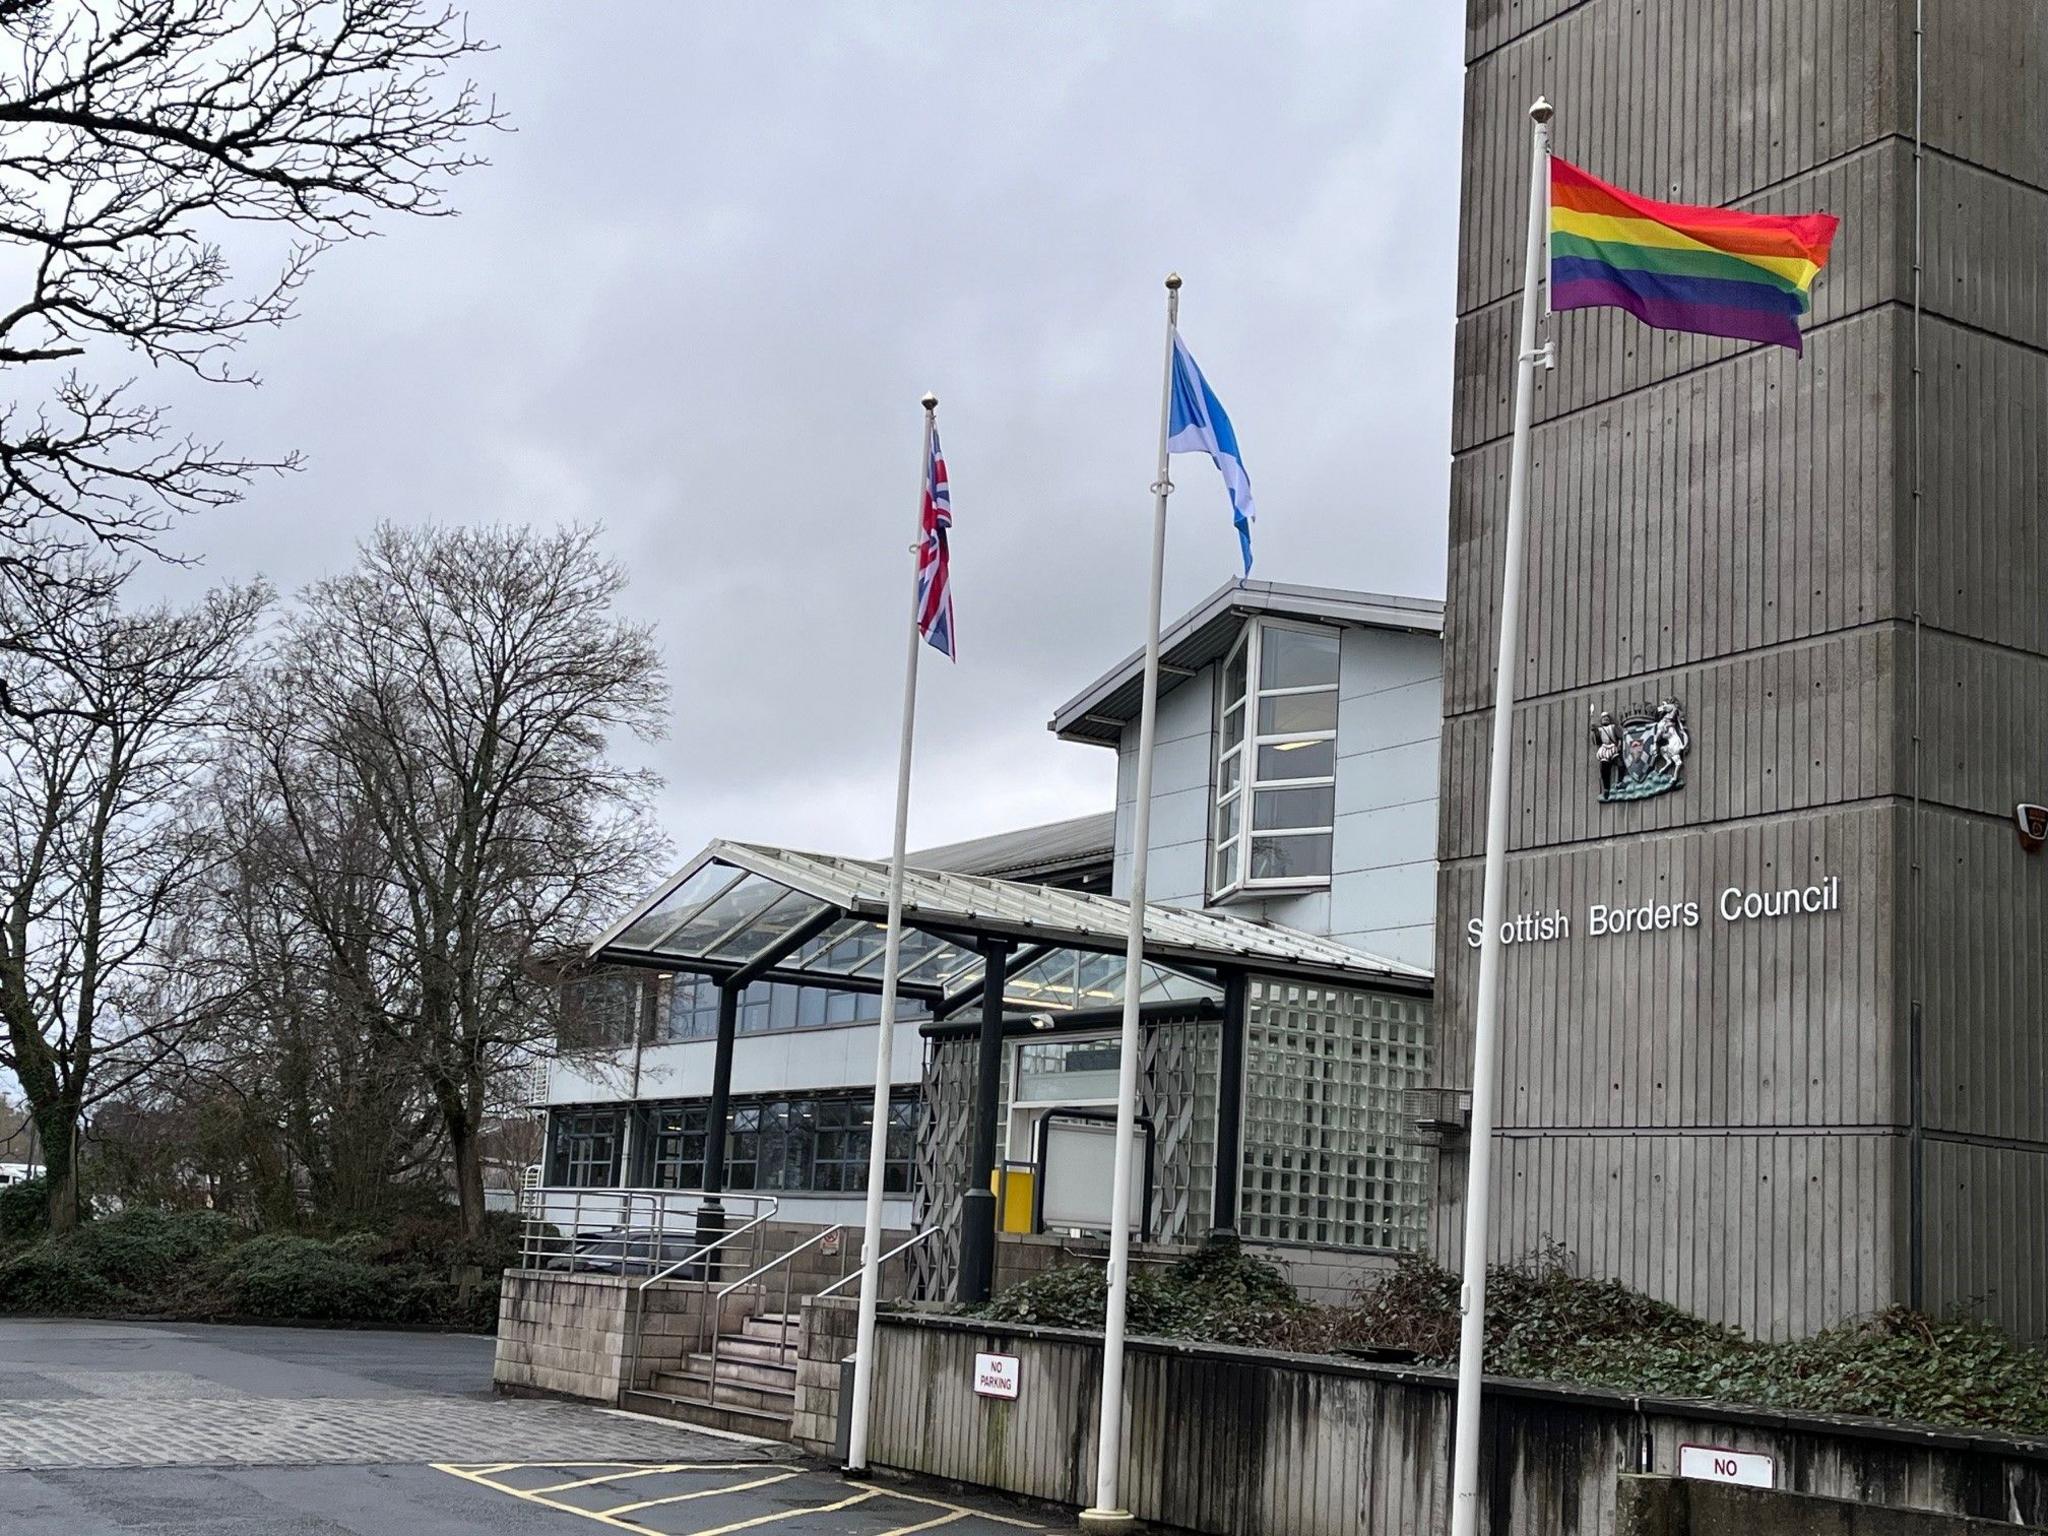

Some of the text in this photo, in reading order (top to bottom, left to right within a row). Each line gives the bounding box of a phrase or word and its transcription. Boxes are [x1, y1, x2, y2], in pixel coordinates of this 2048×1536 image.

[1467, 876, 1838, 948] Sottish Borders Council
[991, 1361, 1003, 1374] NO
[980, 1375, 1012, 1391] PARKING
[1714, 1458, 1738, 1477] NO
